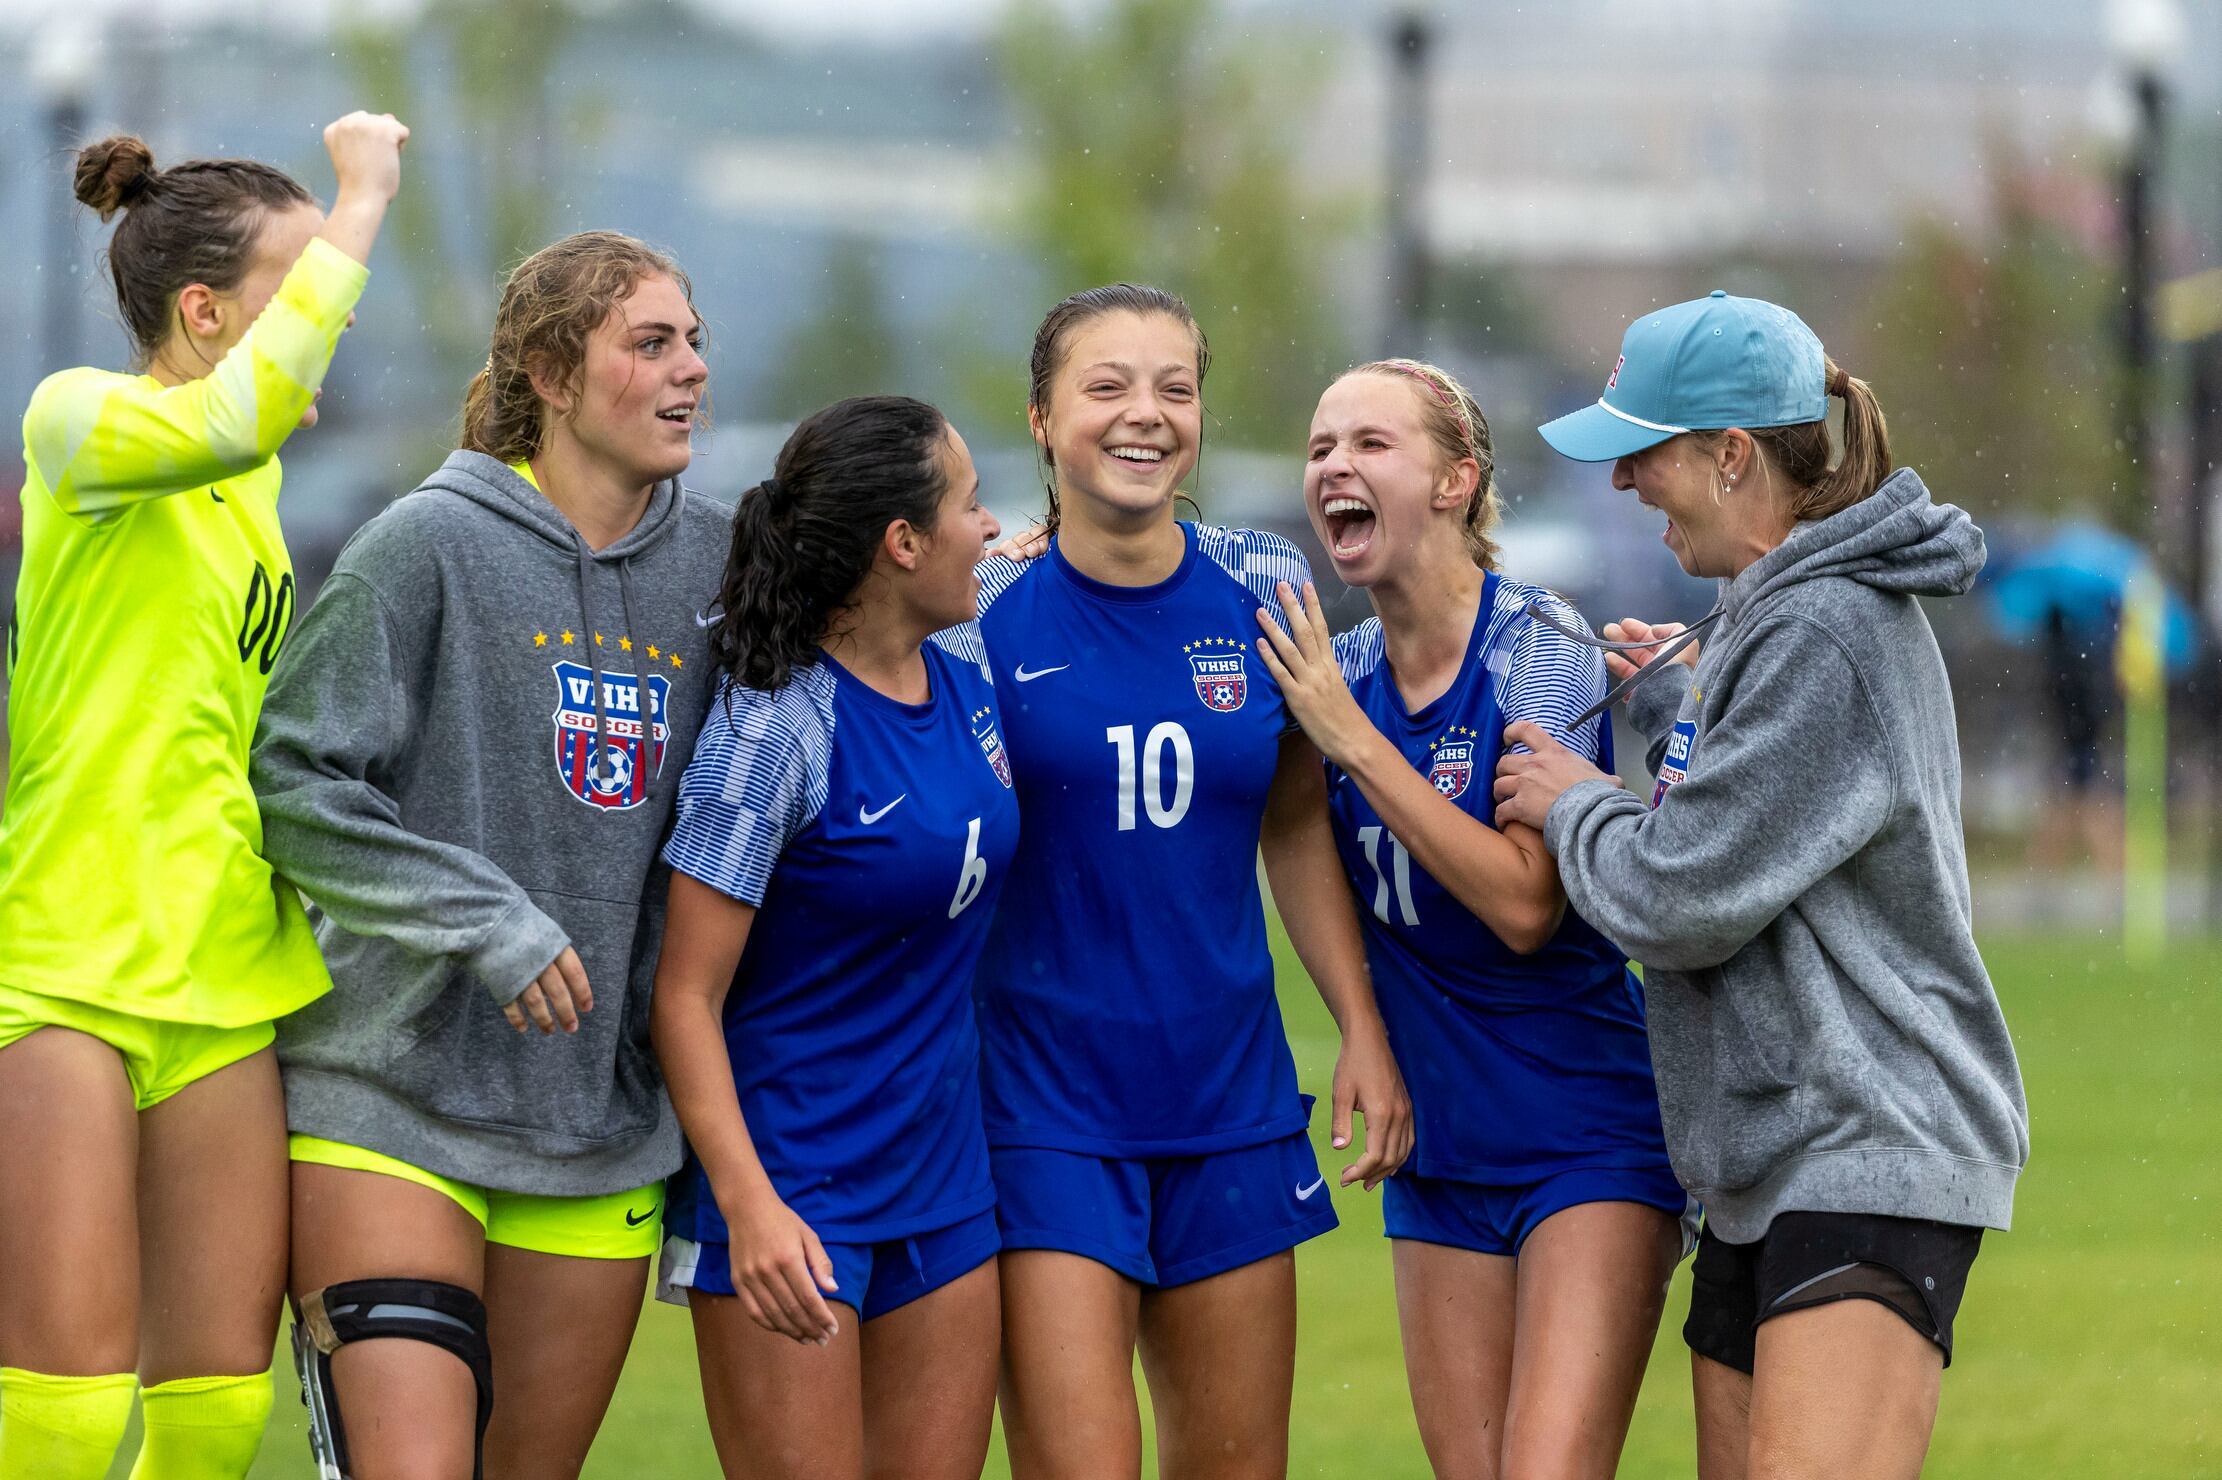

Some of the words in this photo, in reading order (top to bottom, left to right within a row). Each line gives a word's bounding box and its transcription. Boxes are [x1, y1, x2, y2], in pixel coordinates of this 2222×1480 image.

[238, 560, 294, 675] 00
[1196, 660, 1239, 672] VHHS
[980, 728, 999, 752] VHH
[1436, 748, 1467, 761] HHS
[1667, 730, 1689, 761] HHS
[1106, 721, 1194, 831] 10
[948, 817, 987, 919] 6
[1357, 826, 1420, 926] 11
